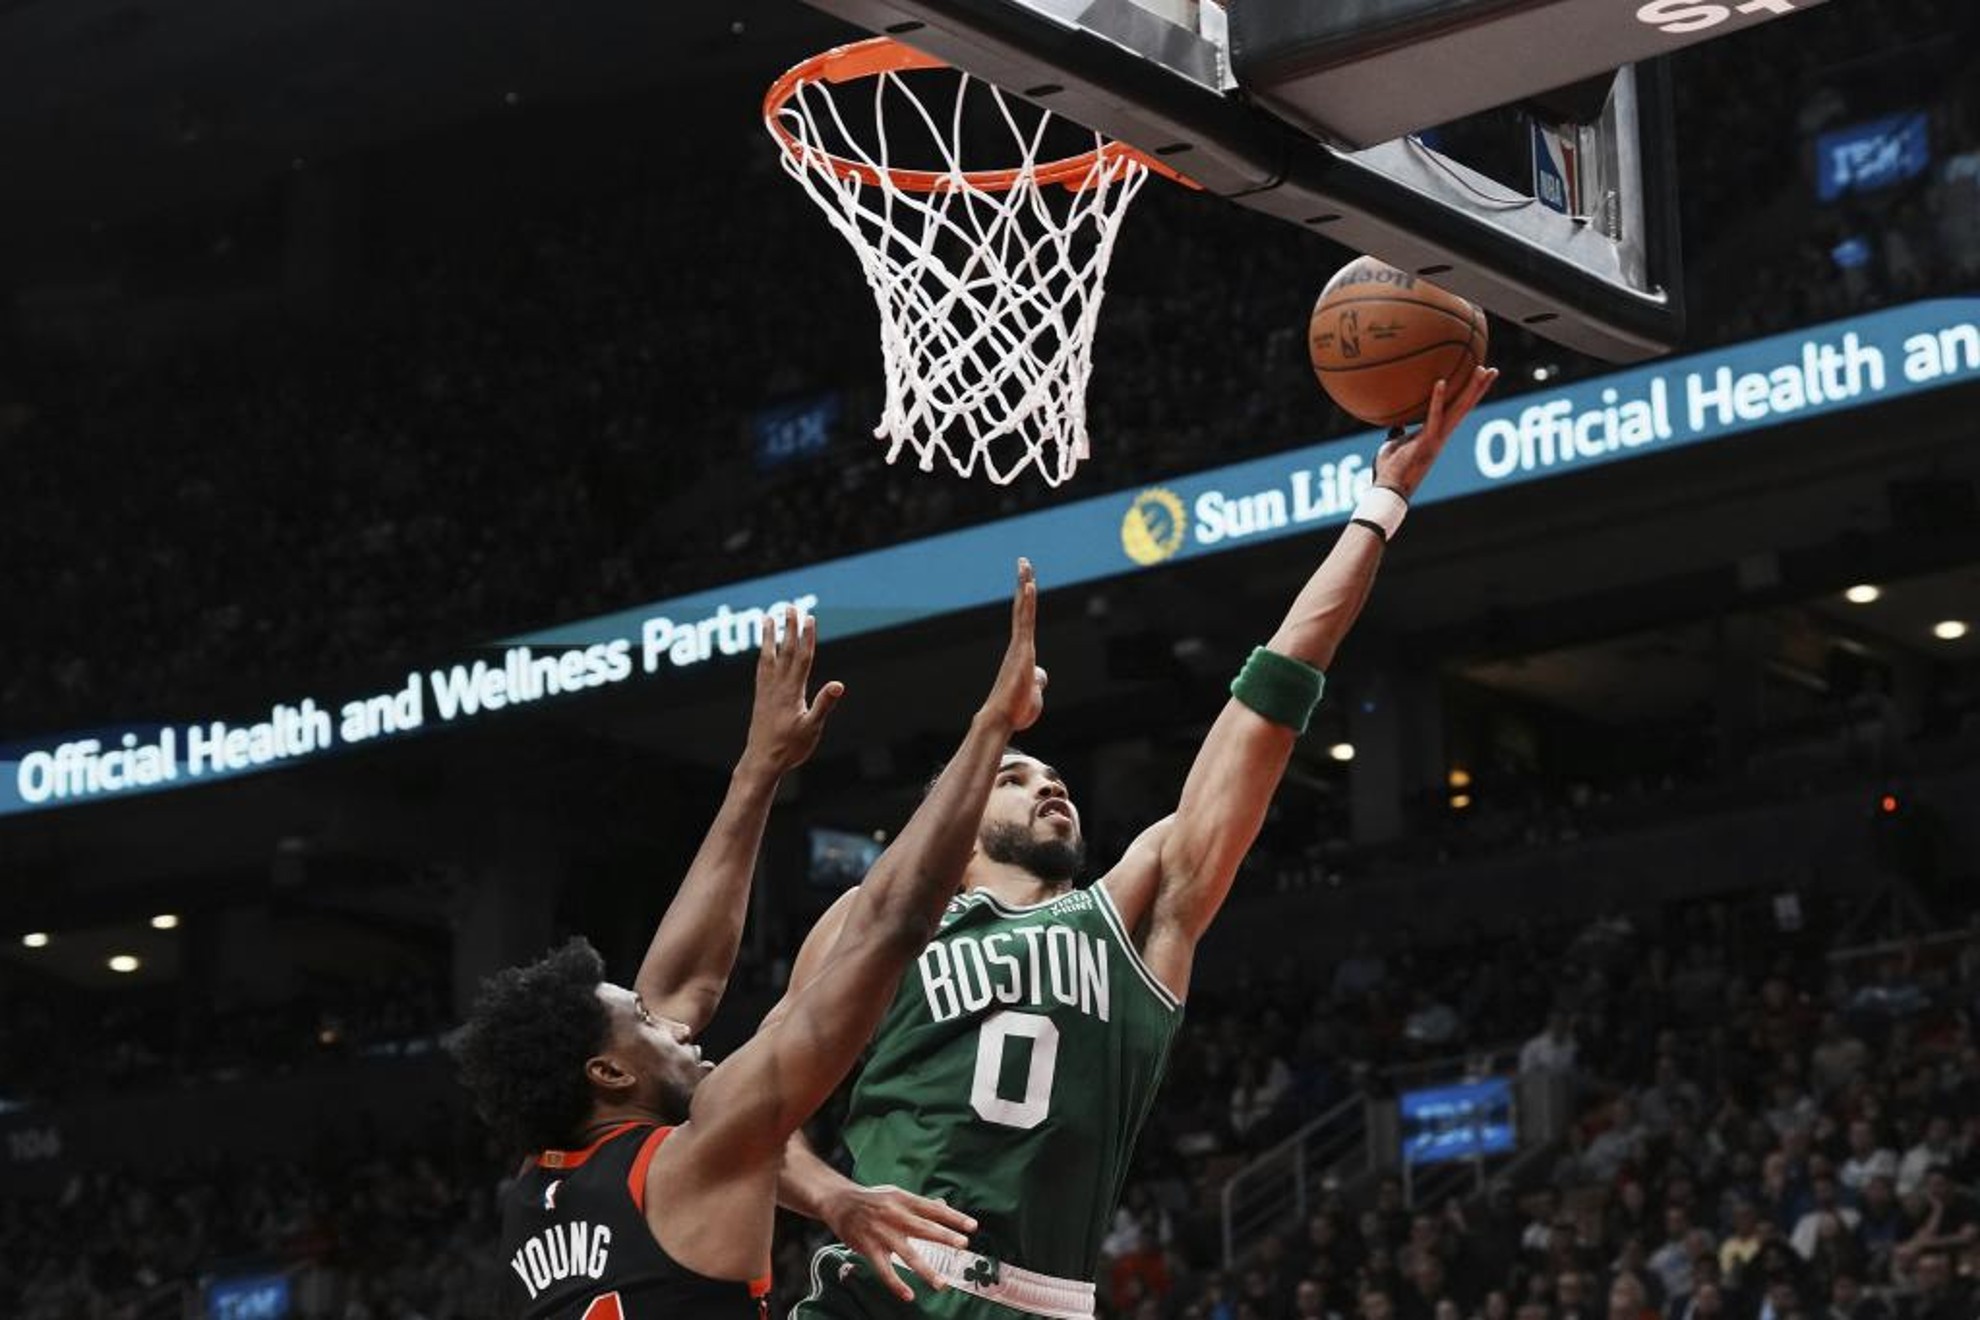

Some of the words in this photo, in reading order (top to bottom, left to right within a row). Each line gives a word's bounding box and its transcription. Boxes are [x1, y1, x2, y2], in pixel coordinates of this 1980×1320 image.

[1475, 376, 1672, 480] Official
[1687, 331, 1886, 432] Health
[1195, 489, 1288, 544] Sun
[17, 726, 177, 803] Official
[187, 697, 332, 775] Health
[340, 672, 423, 742] and
[430, 639, 632, 720] Wellness
[917, 925, 1110, 1023] BOSTON
[970, 1011, 1060, 1130] 0
[510, 1221, 612, 1300] YOUNG
